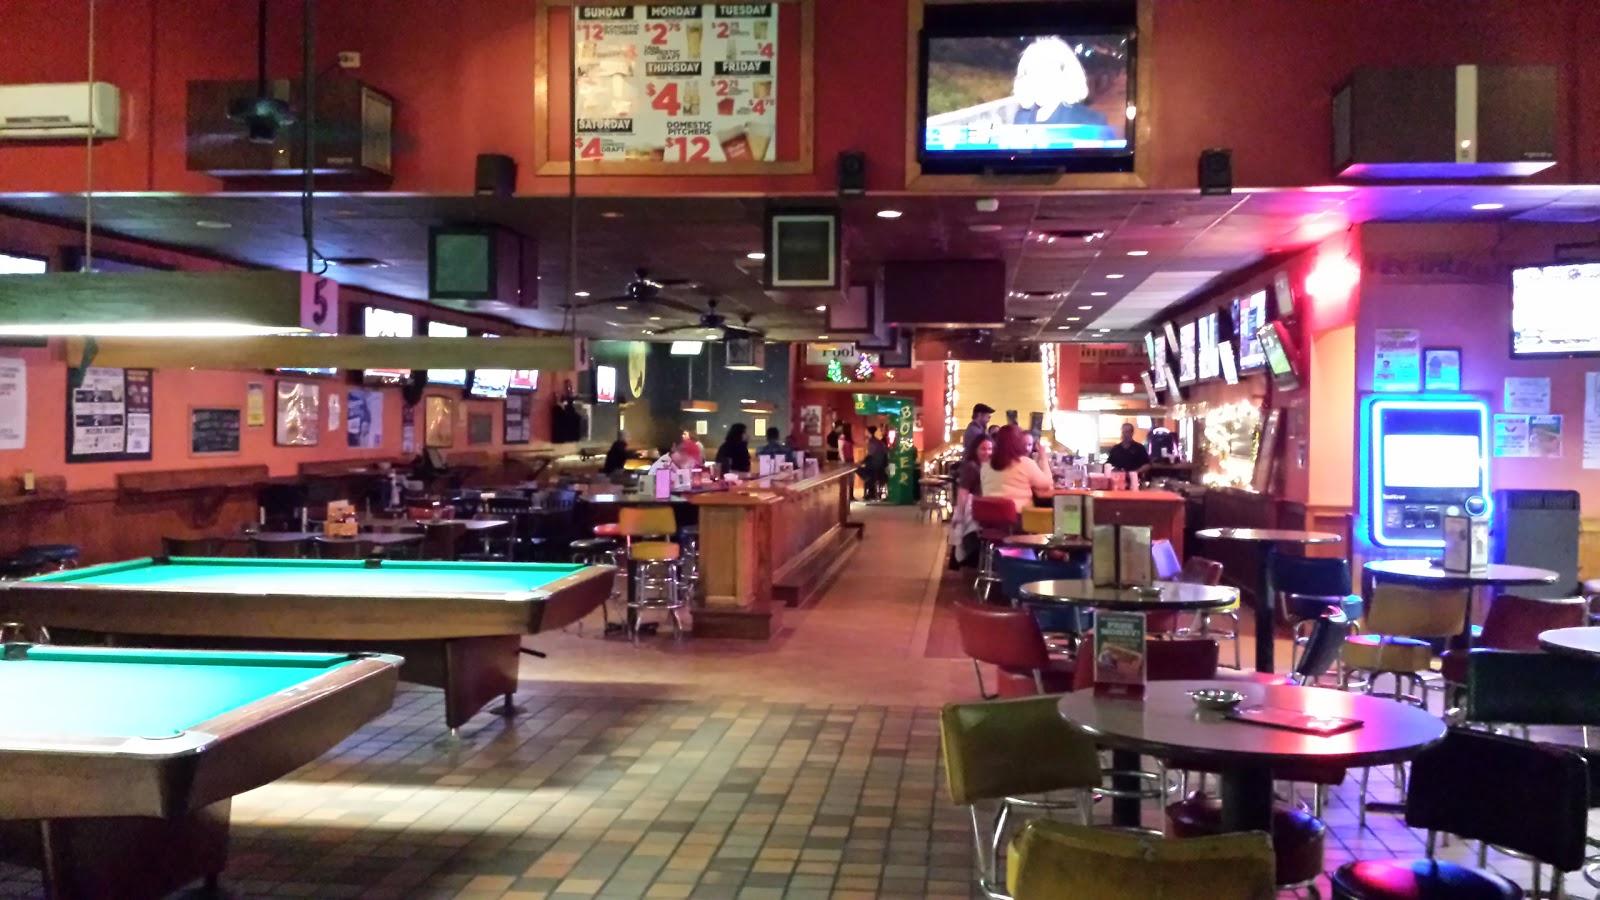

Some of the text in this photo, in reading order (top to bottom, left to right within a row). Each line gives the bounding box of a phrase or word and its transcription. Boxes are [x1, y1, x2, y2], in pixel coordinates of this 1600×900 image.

[584, 7, 626, 17] SUNDAY
[651, 6, 697, 16] MONDAY
[720, 5, 767, 15] TUESDAY
[648, 63, 699, 73] THURSDAY
[723, 62, 761, 71] FRIDAY
[645, 82, 681, 116] $4
[579, 120, 631, 130] SATURDAY
[575, 137, 604, 159] $4
[665, 136, 711, 161] $12
[313, 278, 328, 326] 5
